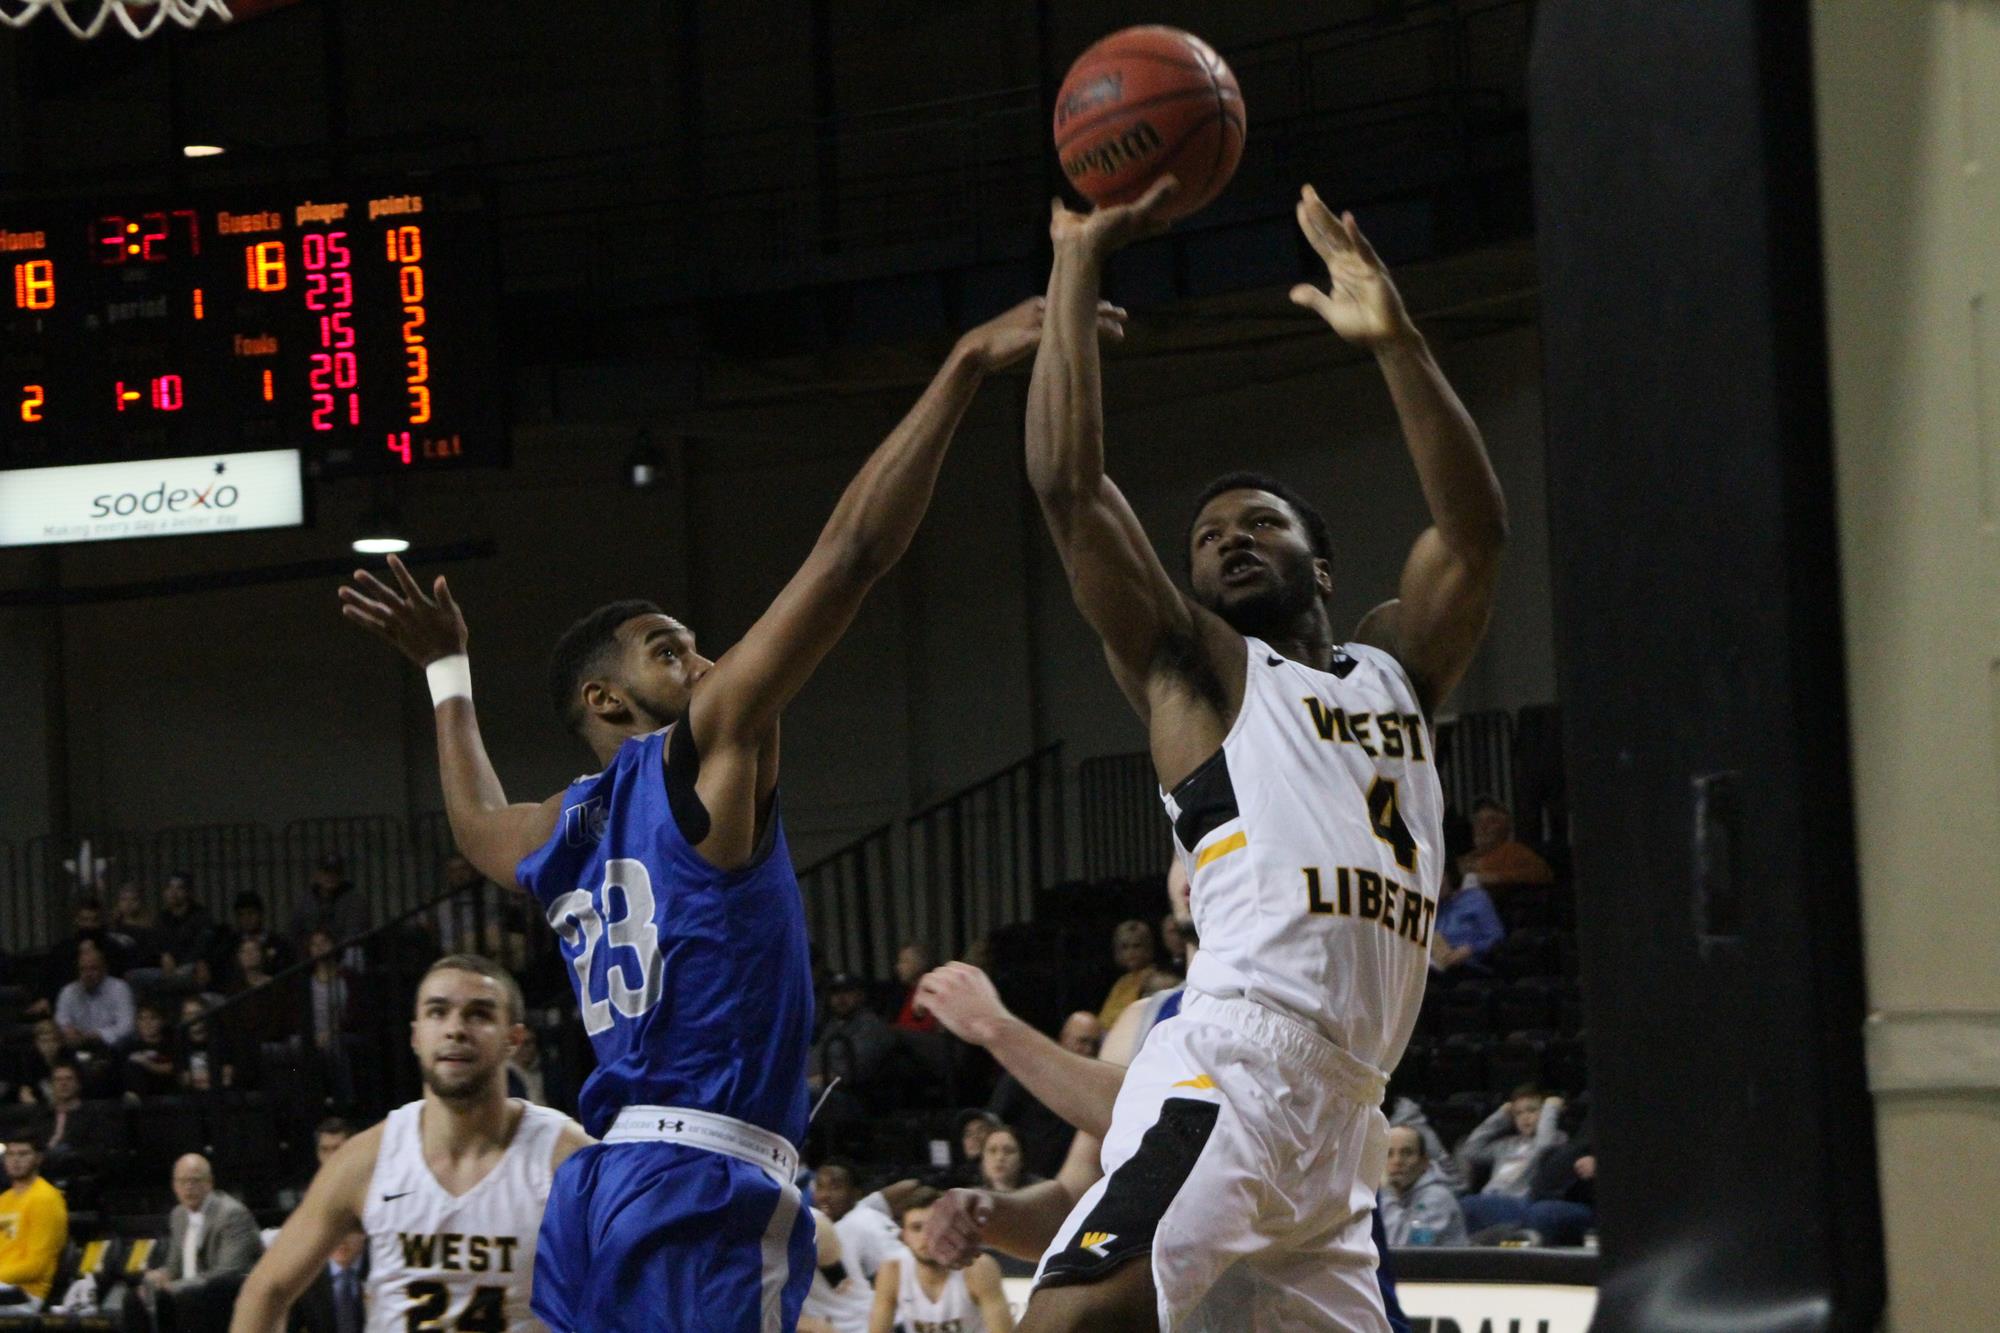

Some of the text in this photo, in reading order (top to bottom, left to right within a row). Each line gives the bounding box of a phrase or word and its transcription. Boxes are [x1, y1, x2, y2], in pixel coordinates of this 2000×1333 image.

[217, 211, 283, 236] Guests
[296, 195, 424, 227] player points
[302, 231, 352, 271] 05
[386, 225, 423, 263] 10
[15, 259, 56, 310] 18
[245, 240, 288, 293] 18
[400, 265, 424, 304] 0
[305, 271, 354, 311] 23
[319, 311, 356, 349] 15
[402, 305, 426, 343] 2
[309, 351, 358, 391] 20
[405, 345, 429, 384] 3
[21, 385, 45, 423] 2
[311, 392, 361, 431] 21
[407, 385, 432, 424] 3
[386, 431, 413, 465] 4
[90, 481, 239, 518] sodexo
[1302, 696, 1427, 762] WEST
[1367, 774, 1420, 875] 4
[546, 858, 665, 1037] 23
[398, 1233, 519, 1272] WEST
[405, 1280, 508, 1333] 24
